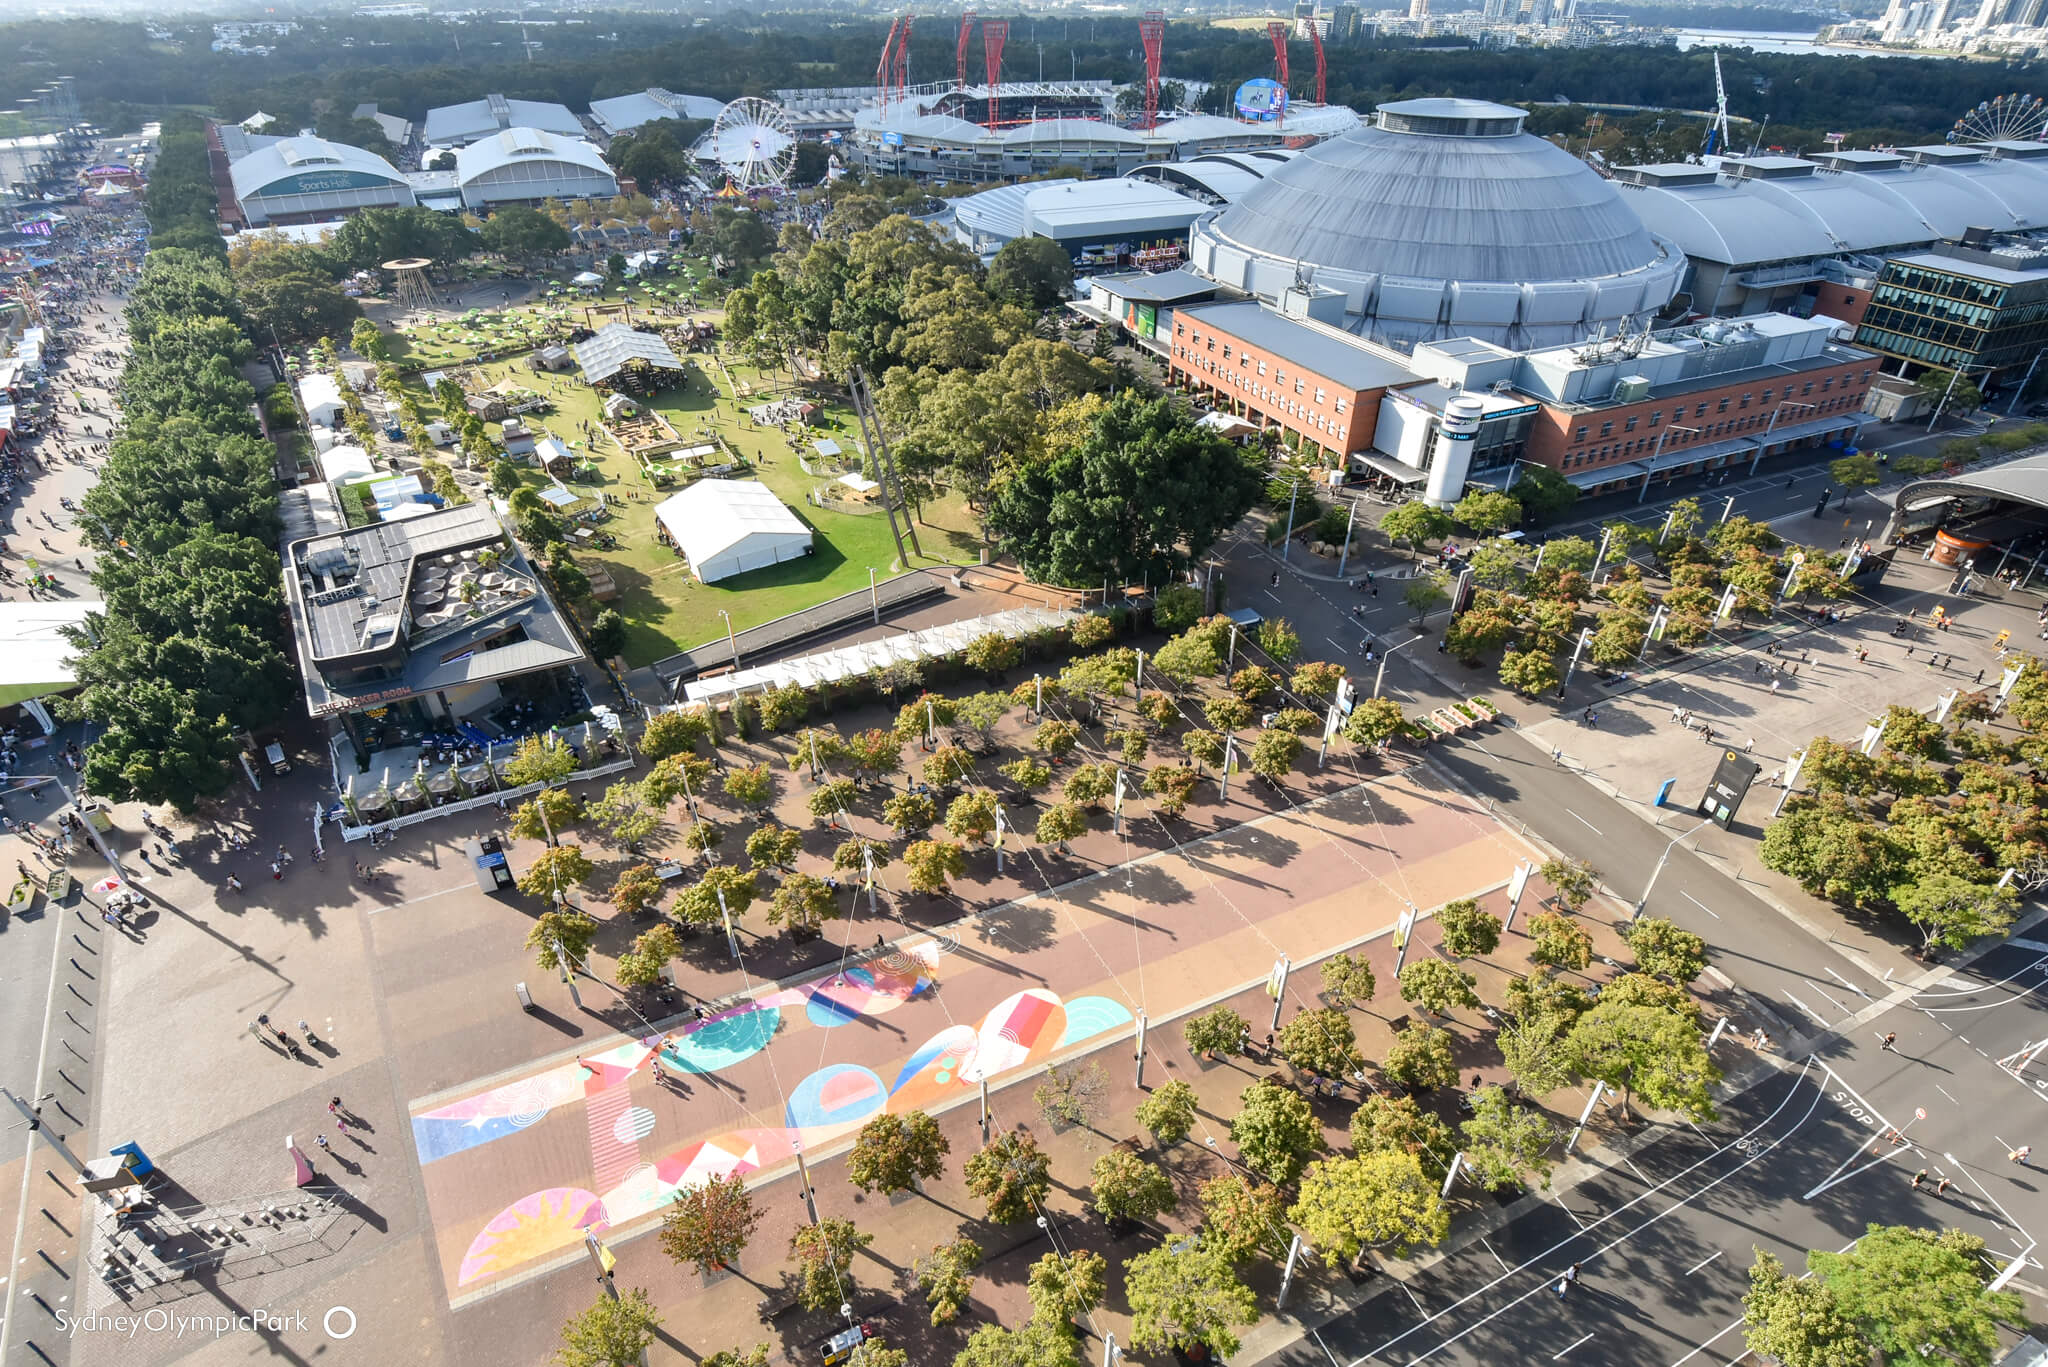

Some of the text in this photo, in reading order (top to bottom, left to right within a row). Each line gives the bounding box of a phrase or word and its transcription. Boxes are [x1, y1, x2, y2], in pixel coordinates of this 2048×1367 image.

[299, 182, 330, 192] Sports
[383, 686, 411, 698] ROOM
[1832, 1091, 1874, 1125] STOP
